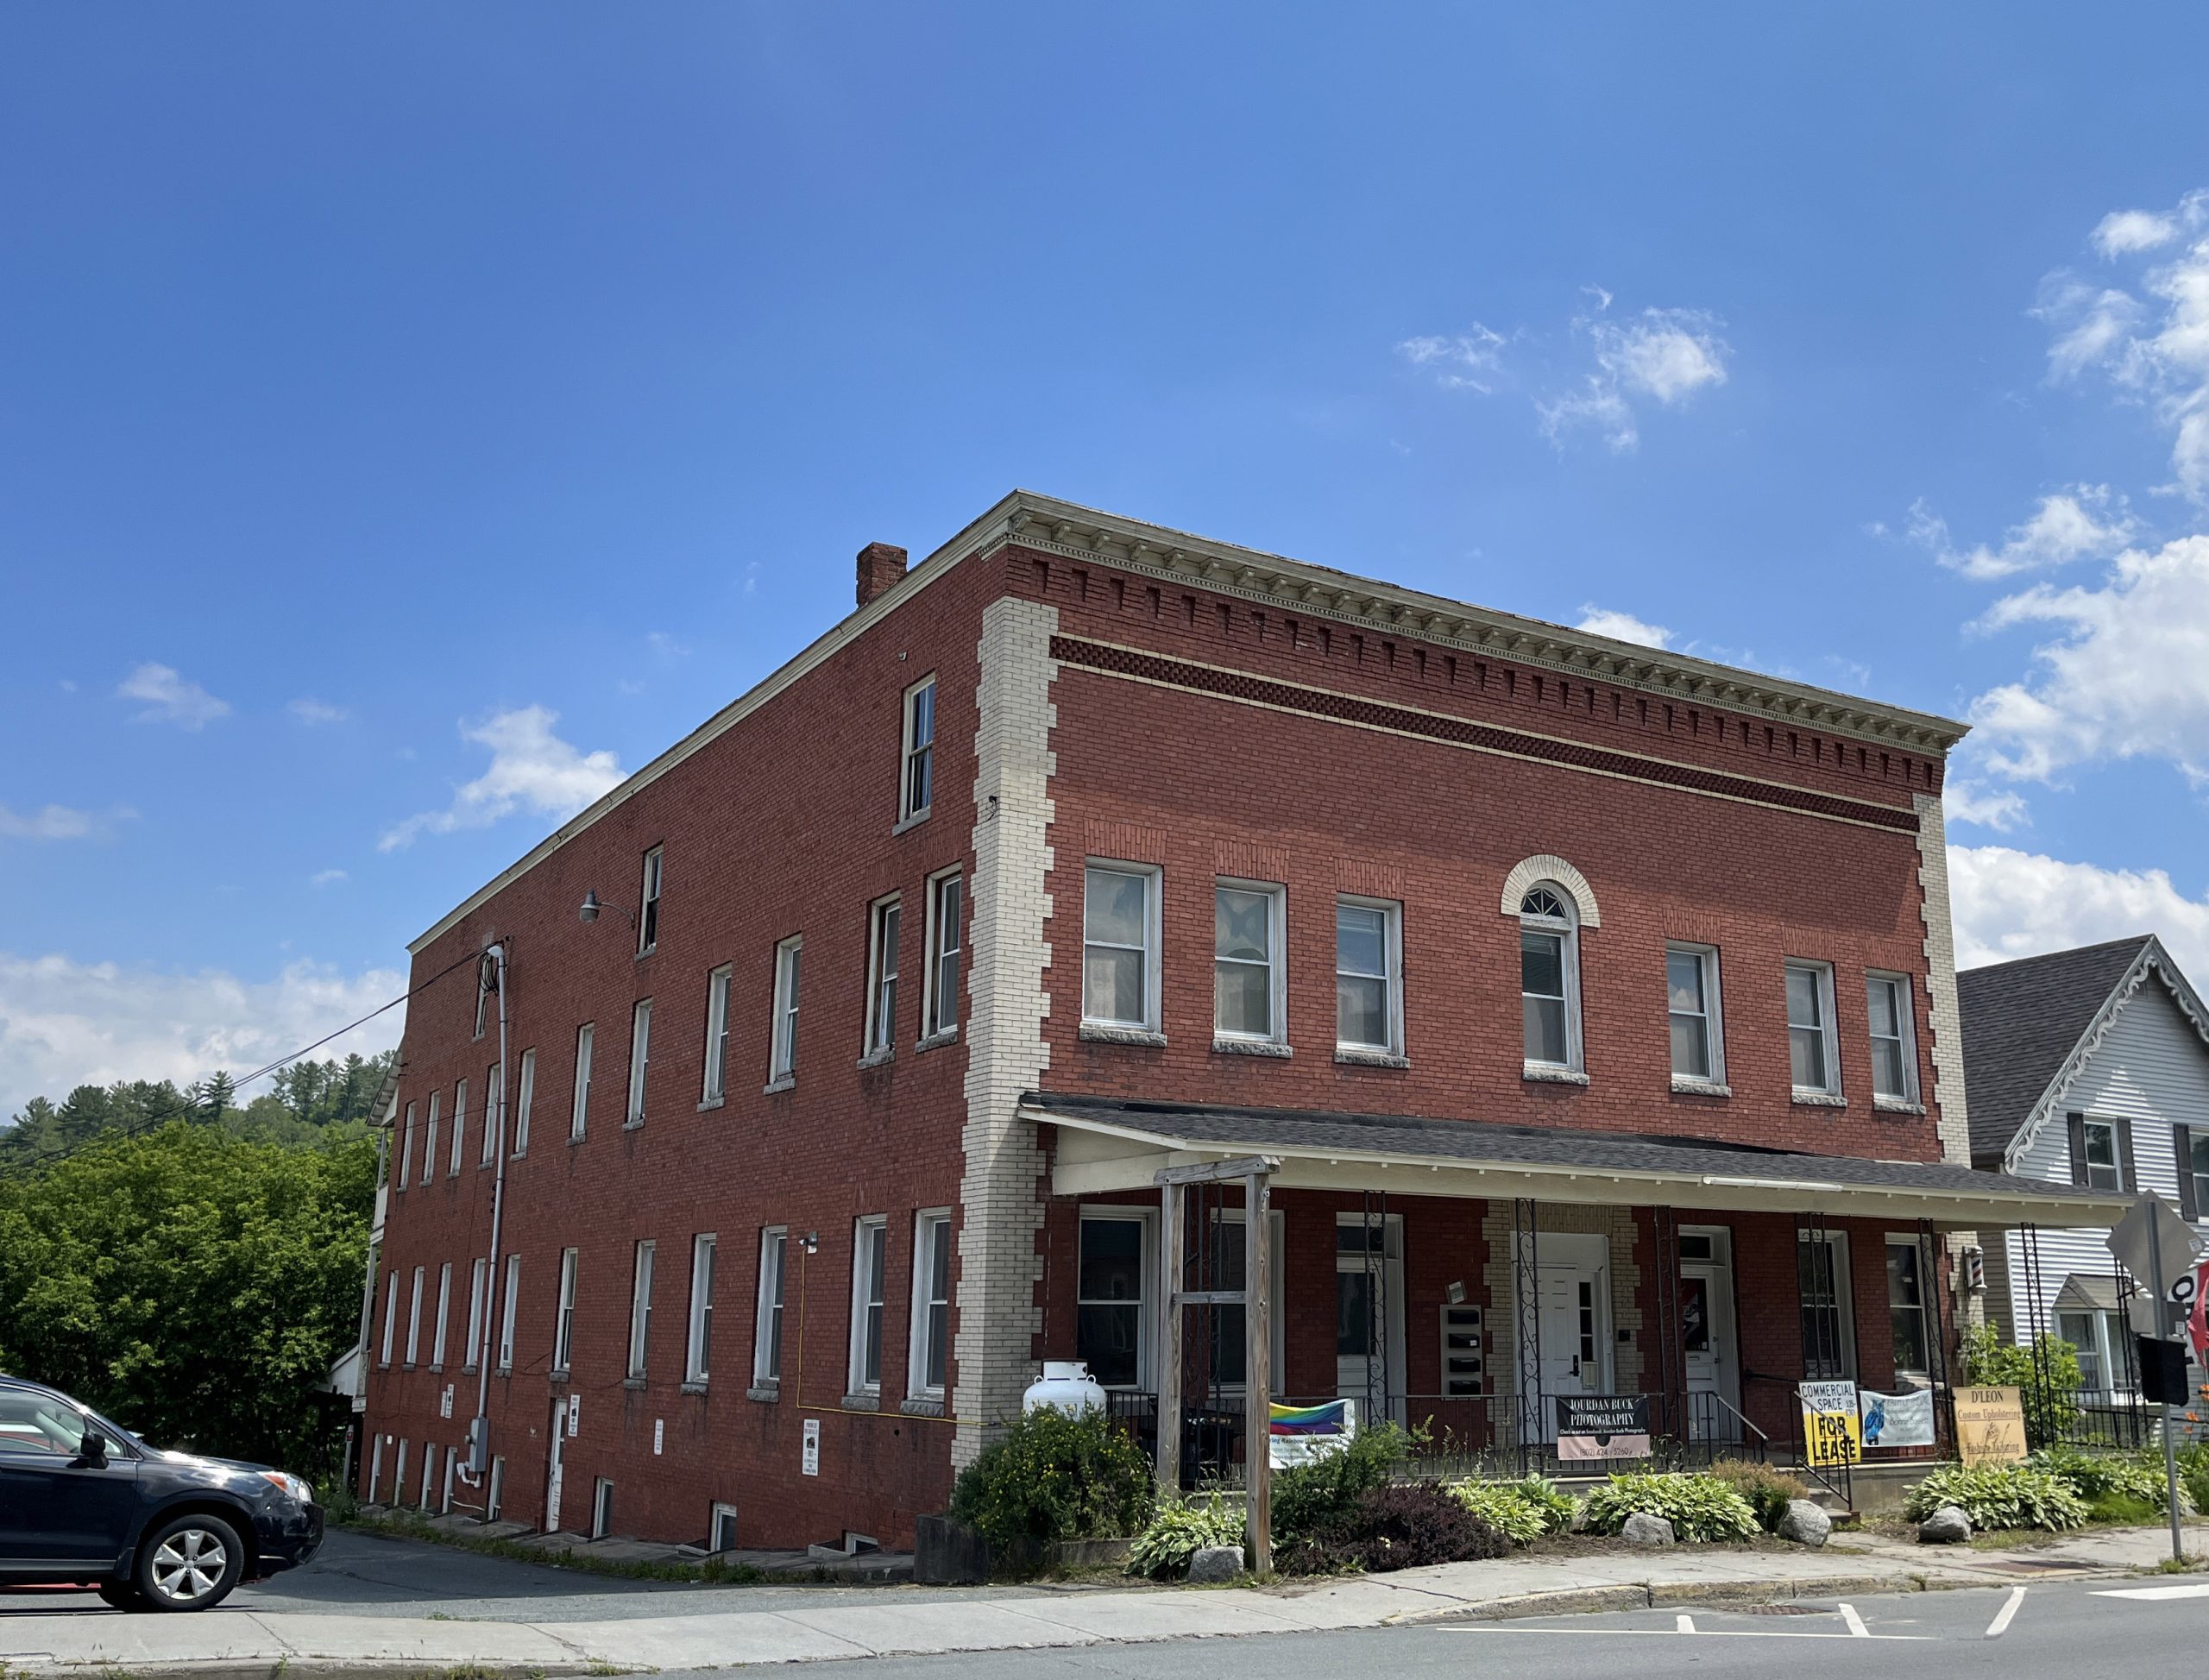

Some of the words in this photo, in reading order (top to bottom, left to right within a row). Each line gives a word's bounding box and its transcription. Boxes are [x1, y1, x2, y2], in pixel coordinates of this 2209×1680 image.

[1802, 1384, 1854, 1398] COMMERCIAL
[1971, 1390, 2004, 1403] D'LEON
[1570, 1399, 1609, 1411] JOURDAN
[1611, 1398, 1634, 1410] BUCK
[1817, 1398, 1842, 1411] SPACE
[1570, 1413, 1635, 1426] PHOTOGRAPHY
[1958, 1409, 1981, 1419] Custom
[1983, 1408, 2021, 1421] Upholstering
[1818, 1416, 1847, 1436] FOR
[1812, 1439, 1856, 1461] LEASE
